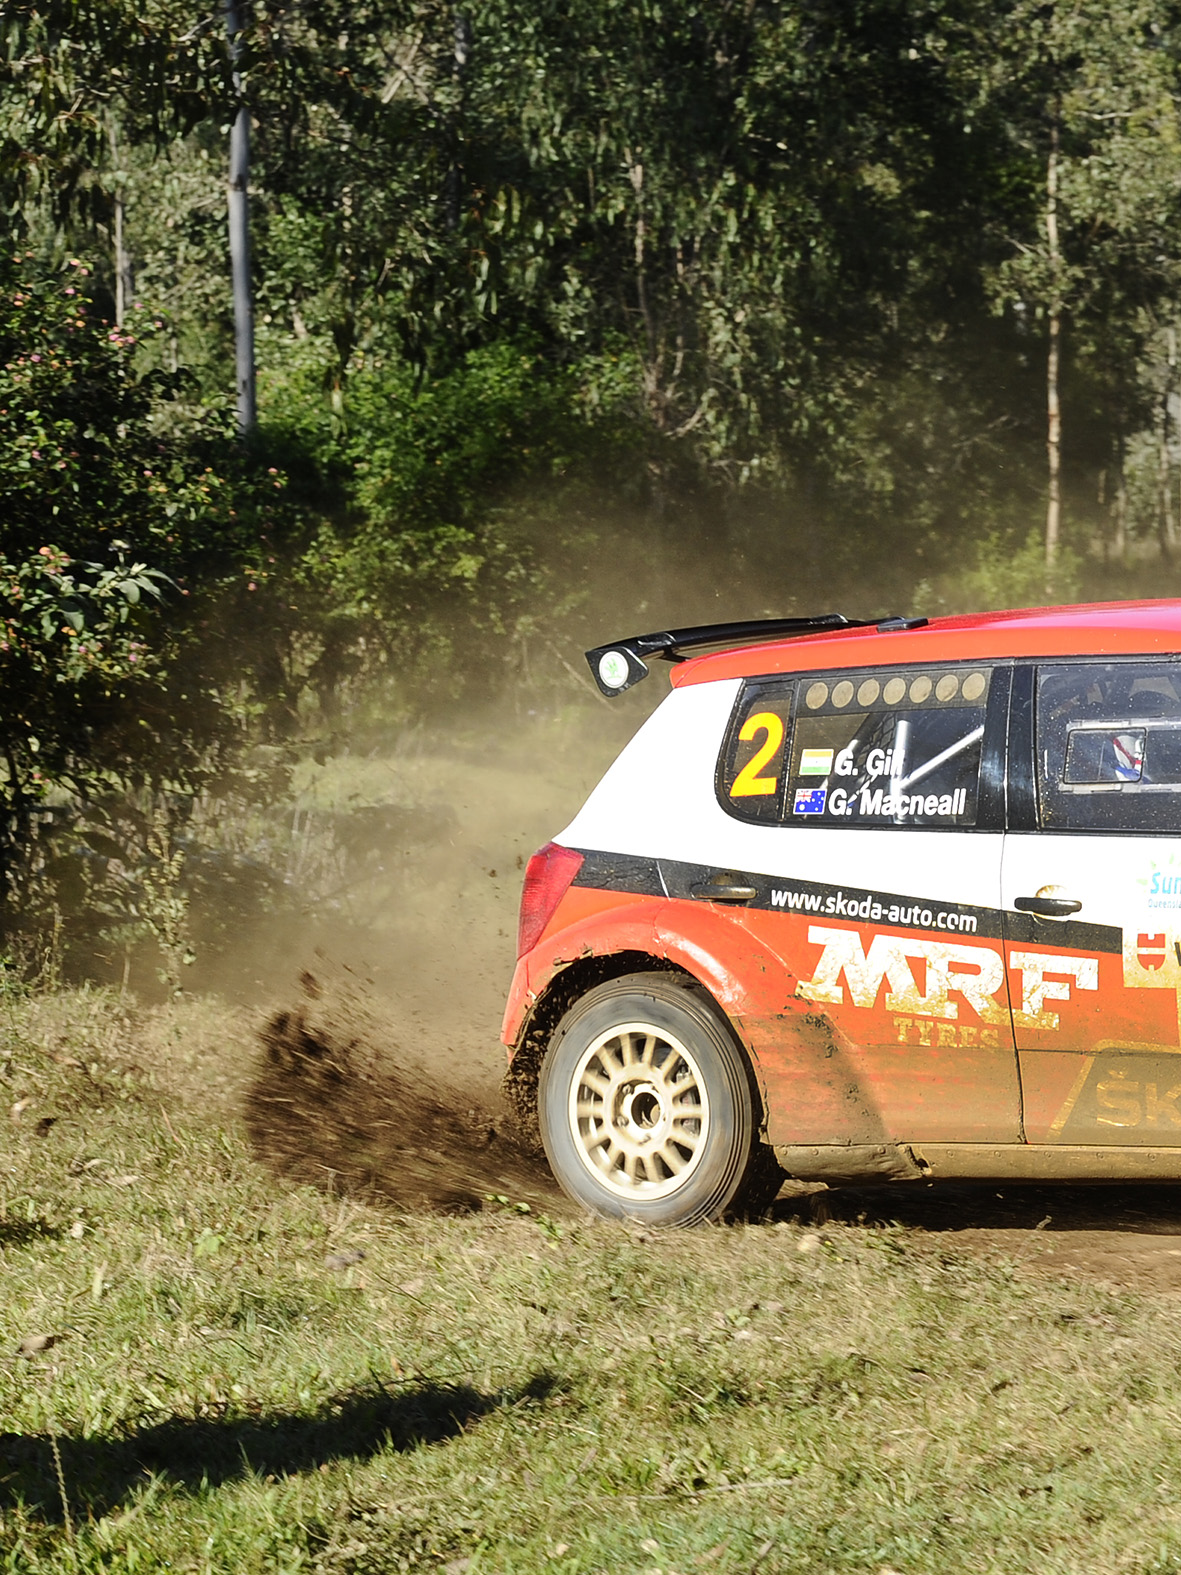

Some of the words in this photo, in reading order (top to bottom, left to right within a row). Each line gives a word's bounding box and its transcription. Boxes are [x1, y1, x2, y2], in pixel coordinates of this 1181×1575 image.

[729, 712, 784, 798] 2
[834, 748, 859, 777] G.
[828, 787, 853, 816] G.
[860, 787, 967, 816] Macneall
[771, 889, 977, 932] www.skoda-auto.com
[795, 925, 1099, 1031] MRF
[893, 1016, 999, 1048] TYRES
